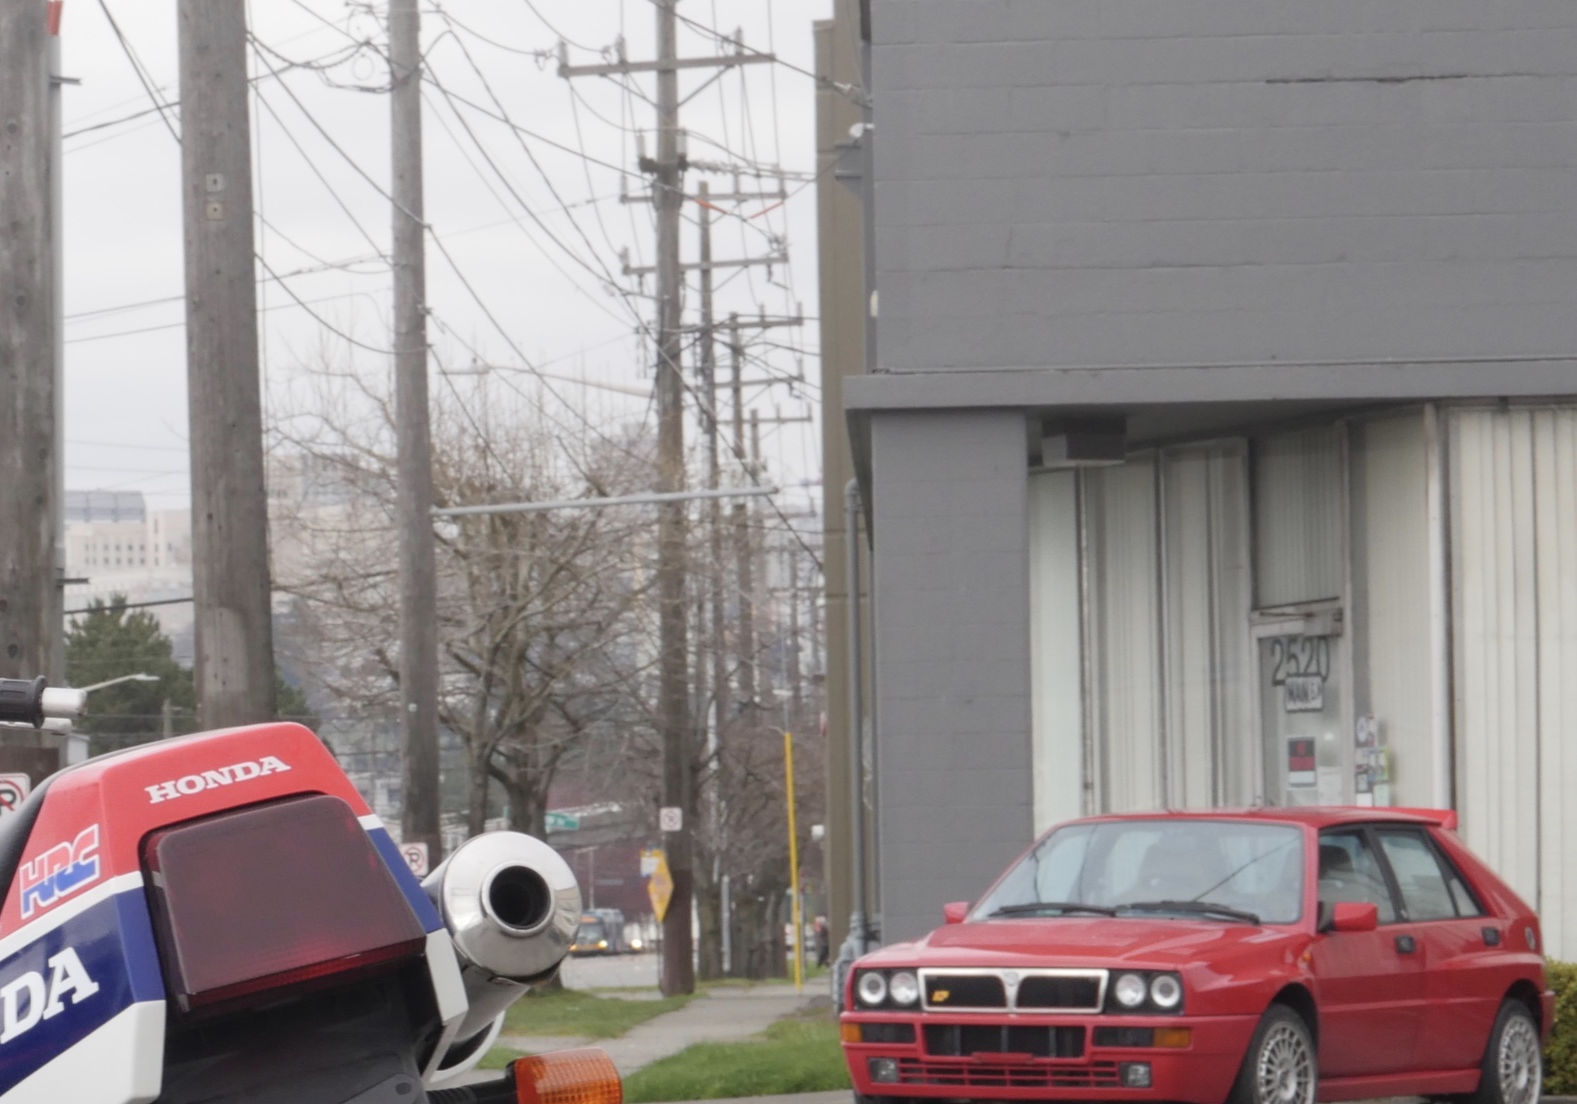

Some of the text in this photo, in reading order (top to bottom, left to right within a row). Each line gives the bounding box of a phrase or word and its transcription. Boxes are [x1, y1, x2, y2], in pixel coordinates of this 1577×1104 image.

[1270, 637, 1330, 686] 2520
[144, 756, 291, 804] HONDA
[19, 823, 100, 920] HRC
